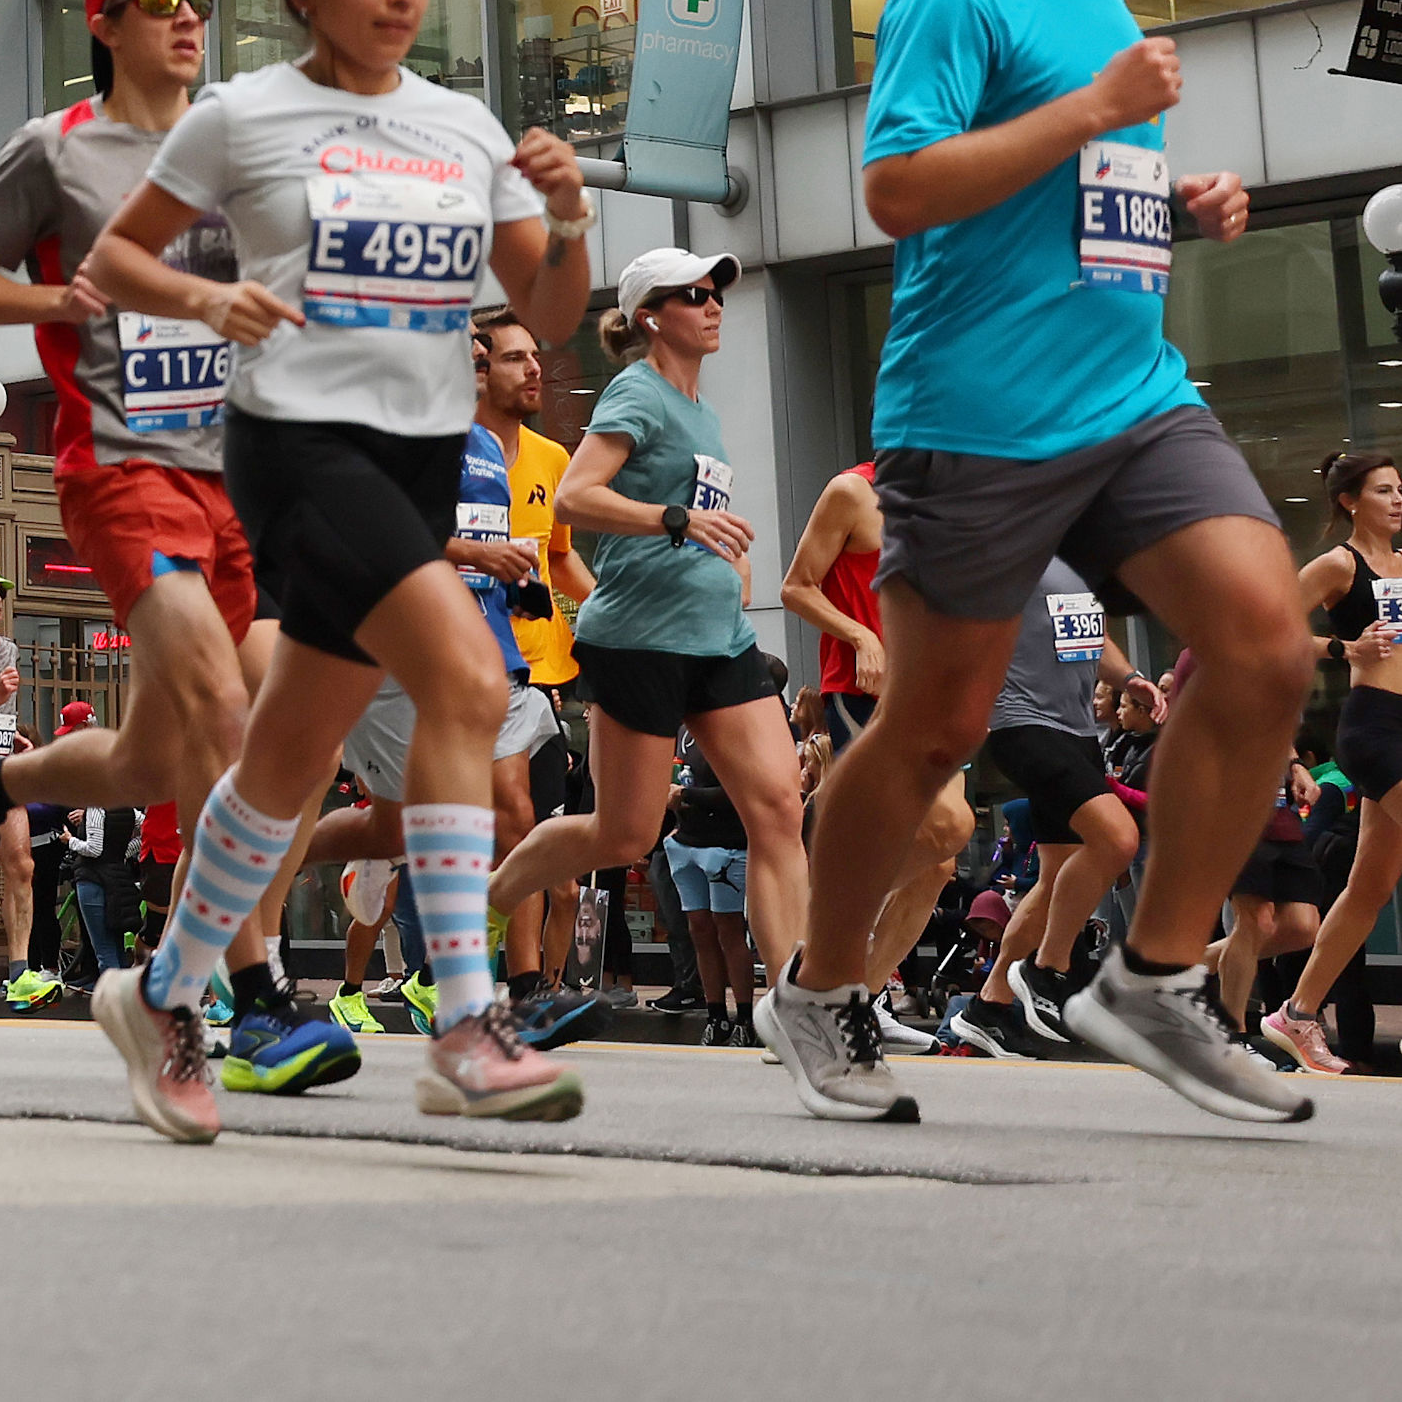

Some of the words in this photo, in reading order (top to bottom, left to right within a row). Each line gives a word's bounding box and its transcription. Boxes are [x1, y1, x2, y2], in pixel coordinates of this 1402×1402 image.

[641, 29, 736, 66] pharmacy
[319, 146, 464, 183] Chicago
[1084, 191, 1105, 232] E
[316, 220, 348, 269] E
[363, 222, 480, 277] 4950
[125, 352, 147, 387] C
[157, 347, 229, 386] 1176
[693, 484, 706, 510] E
[1054, 616, 1068, 638] E
[1070, 613, 1103, 637] 3961
[1378, 601, 1391, 620] E
